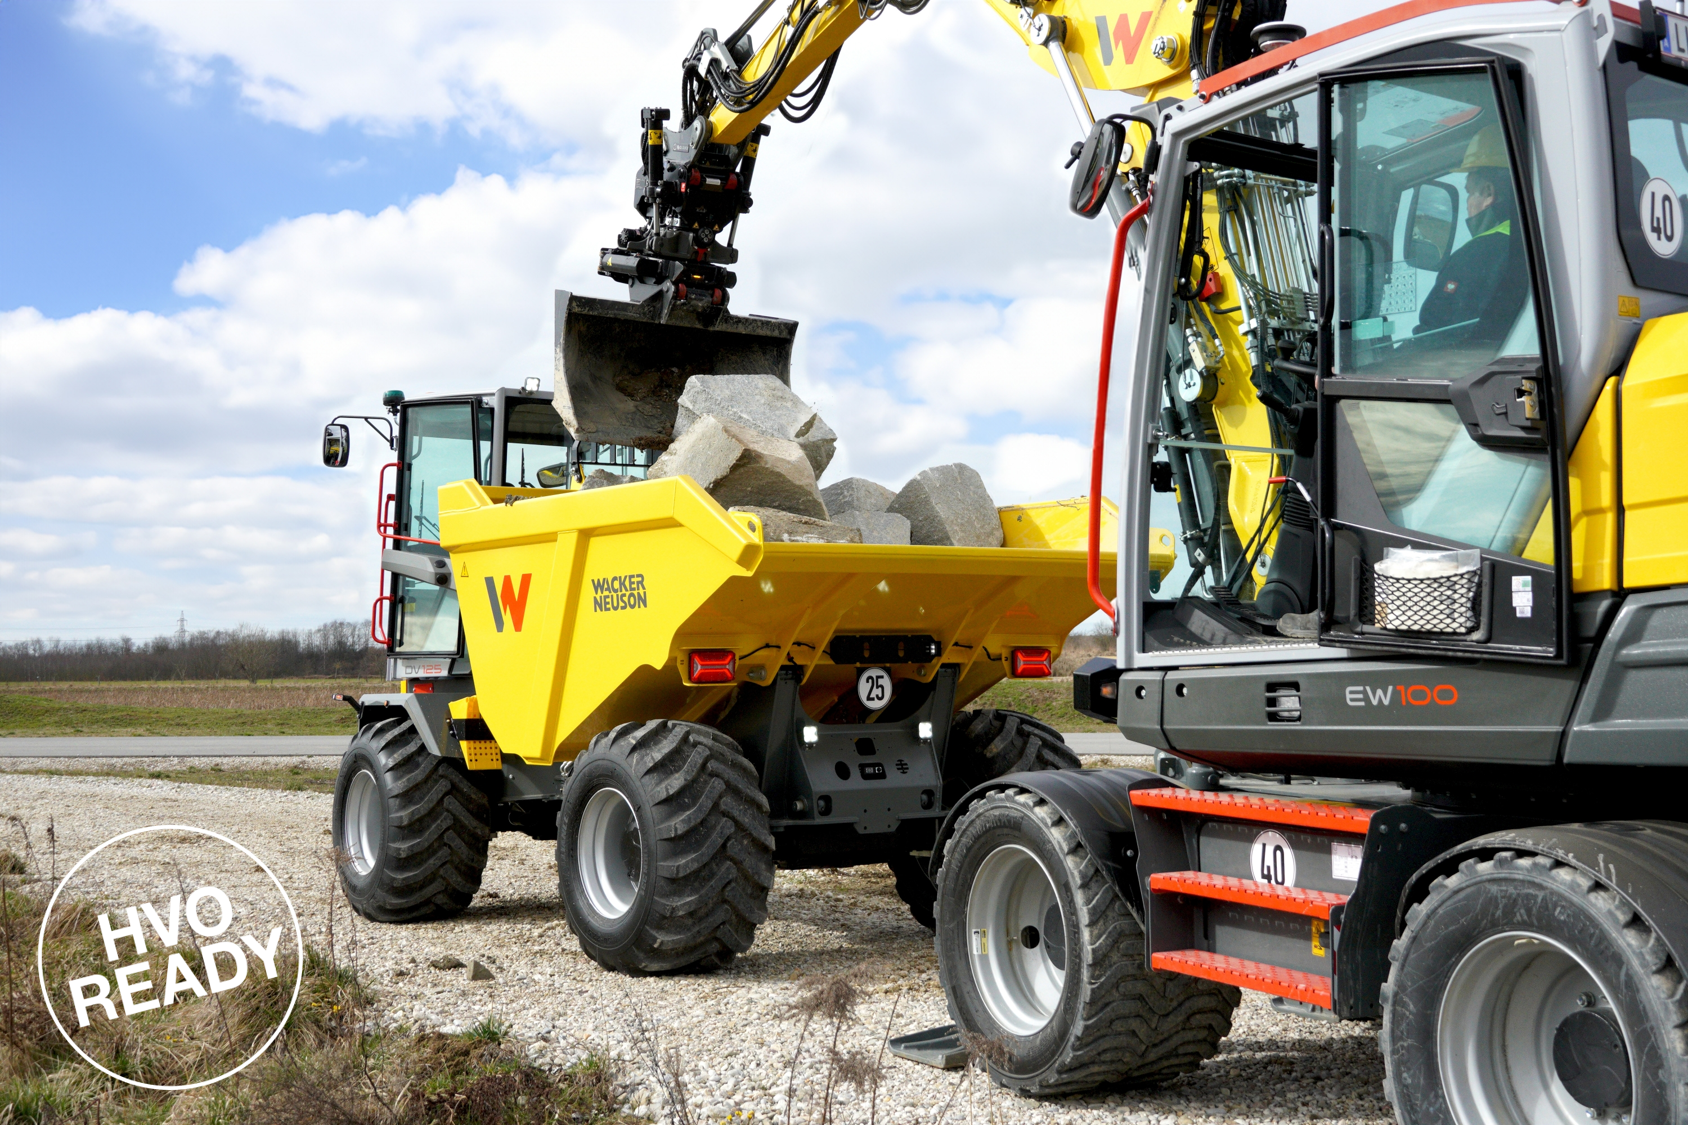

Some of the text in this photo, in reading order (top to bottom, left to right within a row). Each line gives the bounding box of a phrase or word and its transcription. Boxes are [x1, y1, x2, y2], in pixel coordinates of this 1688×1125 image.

[1650, 191, 1674, 243] 40
[591, 573, 647, 595] WACKER
[484, 573, 533, 633] W
[593, 590, 648, 613] NEUSON
[404, 664, 443, 675] DV125
[865, 675, 885, 702] 25
[1345, 684, 1458, 706] EW100
[1261, 842, 1285, 886] 40
